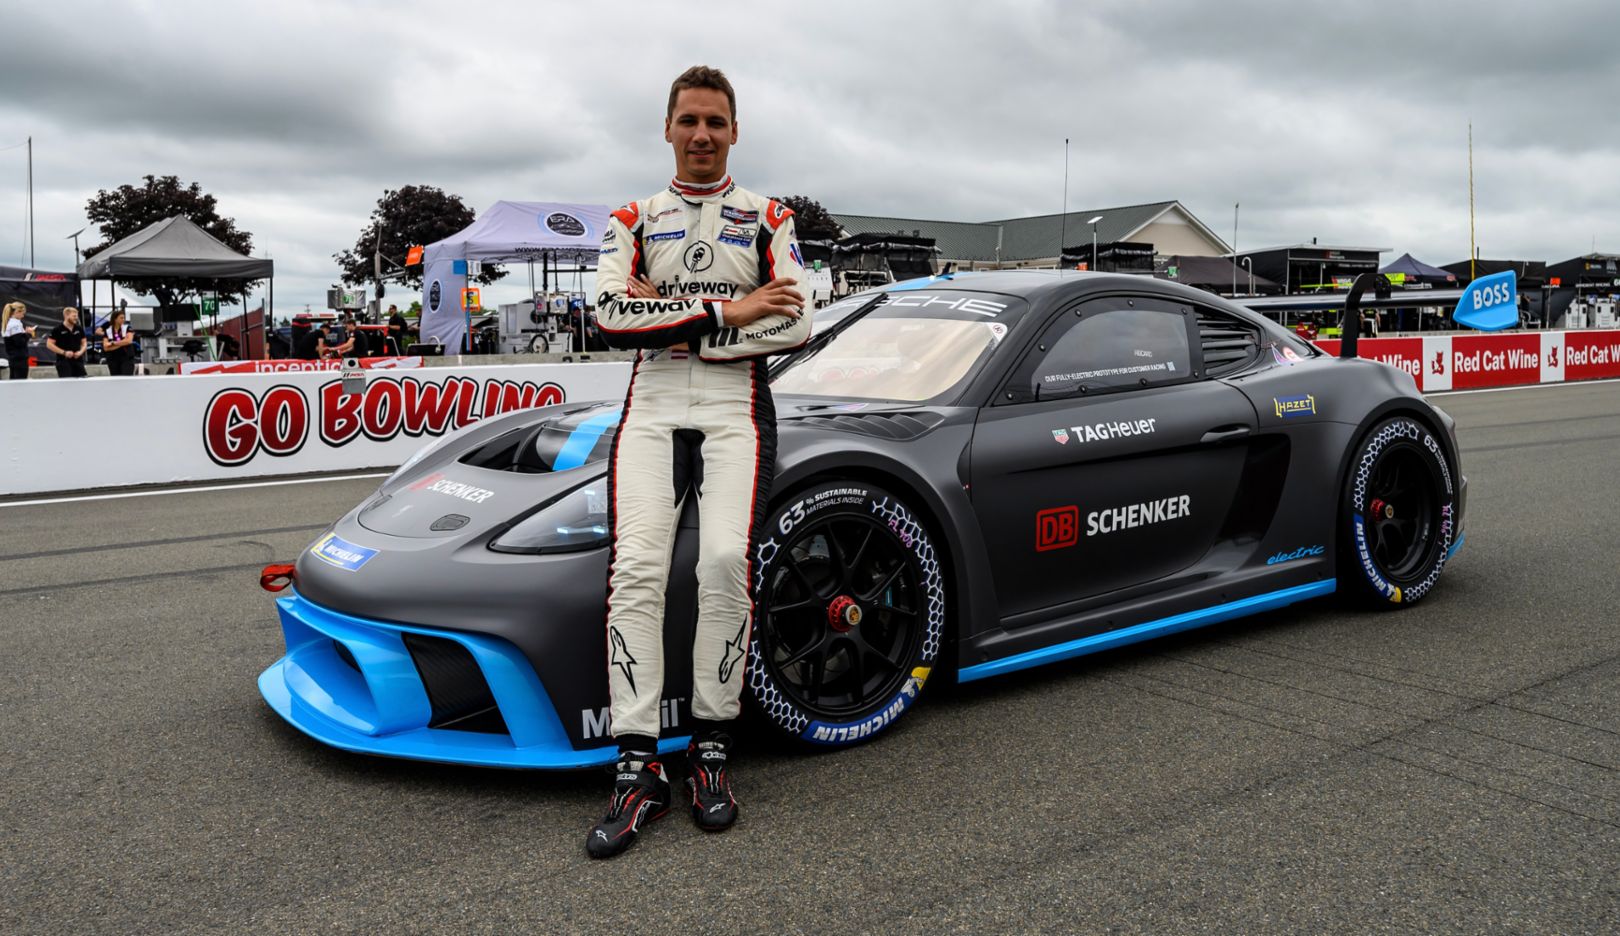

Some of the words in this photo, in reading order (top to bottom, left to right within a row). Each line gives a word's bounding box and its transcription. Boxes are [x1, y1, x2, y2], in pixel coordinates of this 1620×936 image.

[653, 232, 684, 240] MICHELIN
[656, 274, 739, 298] driveway
[1473, 282, 1511, 310] BOSS
[255, 360, 343, 374] inceptio
[1382, 358, 1421, 376] Wine
[1454, 351, 1480, 373] Red
[1482, 350, 1505, 372] Cat
[1508, 349, 1538, 370] Wine
[1566, 345, 1588, 366] Red
[1589, 344, 1609, 365] Cat
[1278, 399, 1311, 413] HAZET
[203, 384, 310, 467] GO
[1424, 434, 1438, 453] 63
[427, 479, 495, 503] SCHENKER
[779, 500, 806, 535] 63
[814, 488, 868, 502] SUSTAINABLE
[806, 497, 842, 516] MATERIALS
[841, 496, 865, 505] INSIDE
[1041, 513, 1074, 545] DB
[1086, 494, 1191, 536] SCHENKER
[1267, 545, 1325, 565] electric
[1356, 521, 1387, 593] MICHELIN
[582, 699, 679, 739] Mil
[812, 696, 905, 742] MICHELIN
